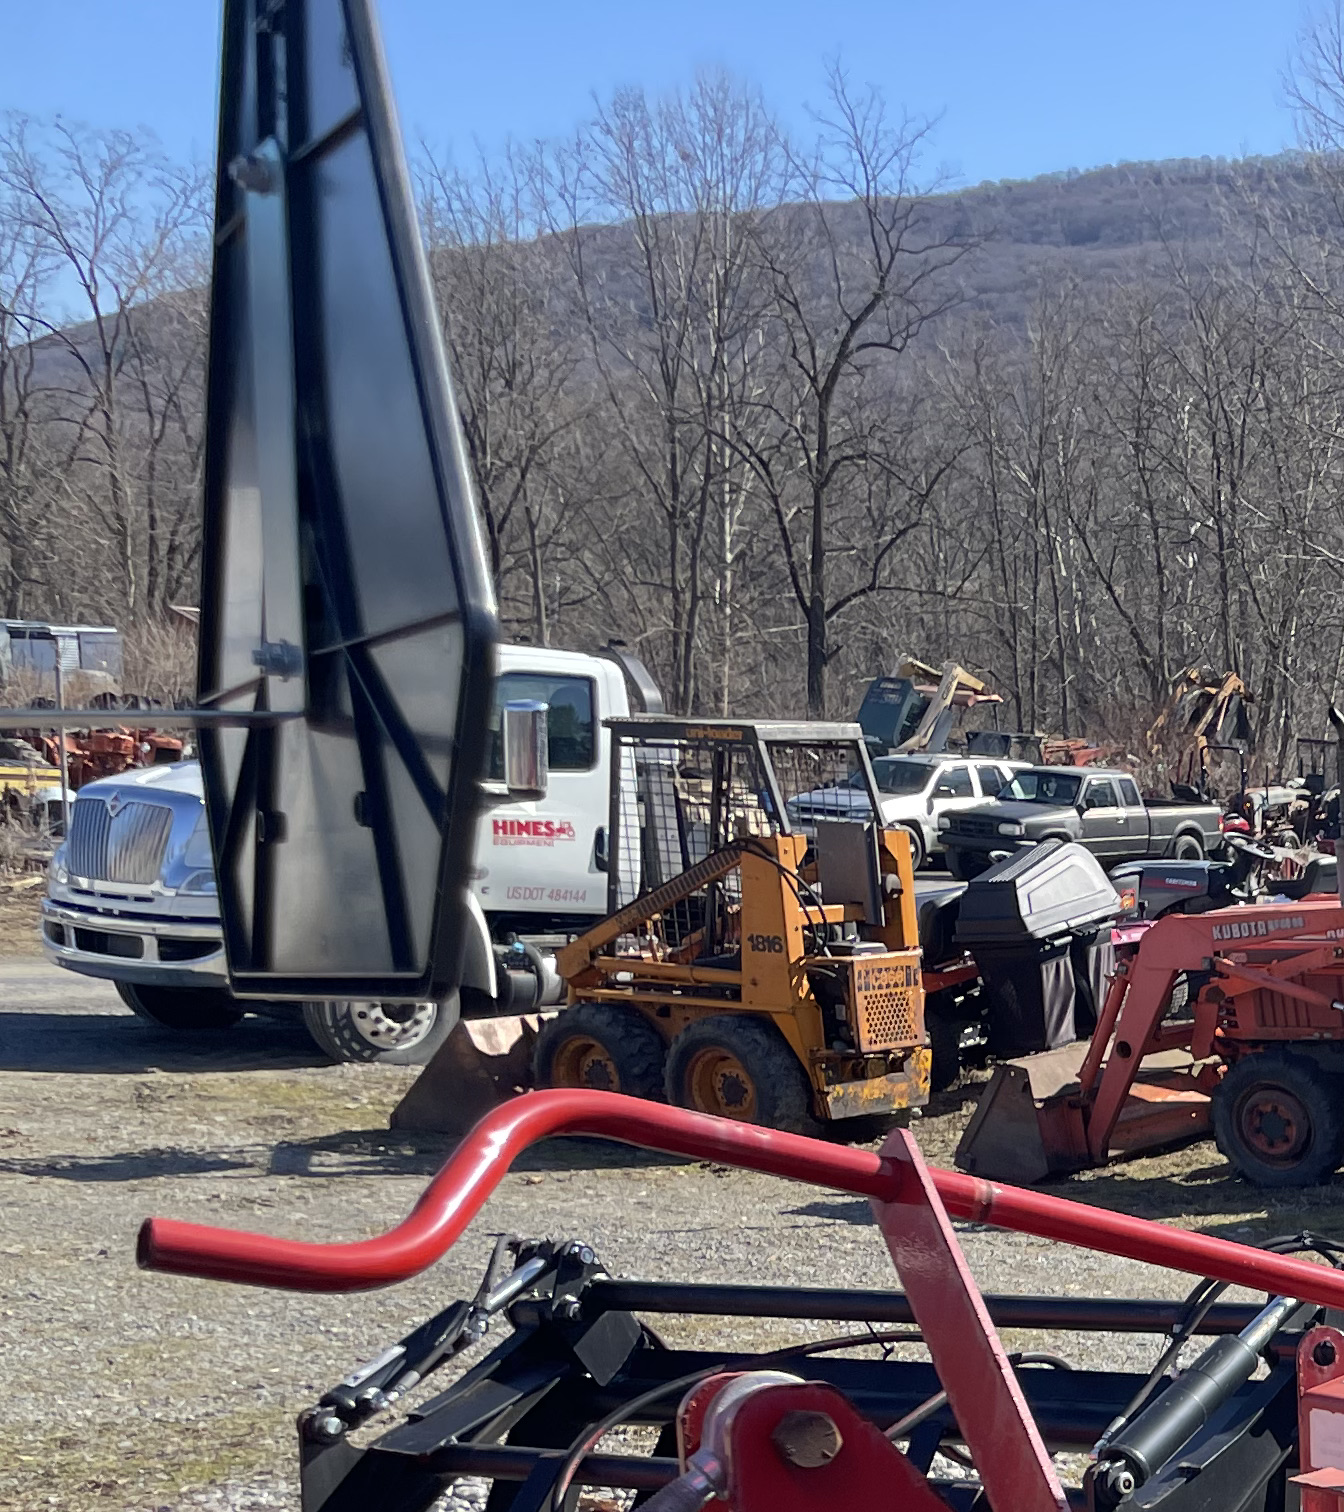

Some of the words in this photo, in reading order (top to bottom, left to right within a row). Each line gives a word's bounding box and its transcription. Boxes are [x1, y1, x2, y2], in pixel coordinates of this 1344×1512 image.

[492, 819, 555, 836] HINES
[548, 888, 587, 902] 484144
[1212, 919, 1267, 940] KUBOTA
[747, 933, 783, 953] 1816
